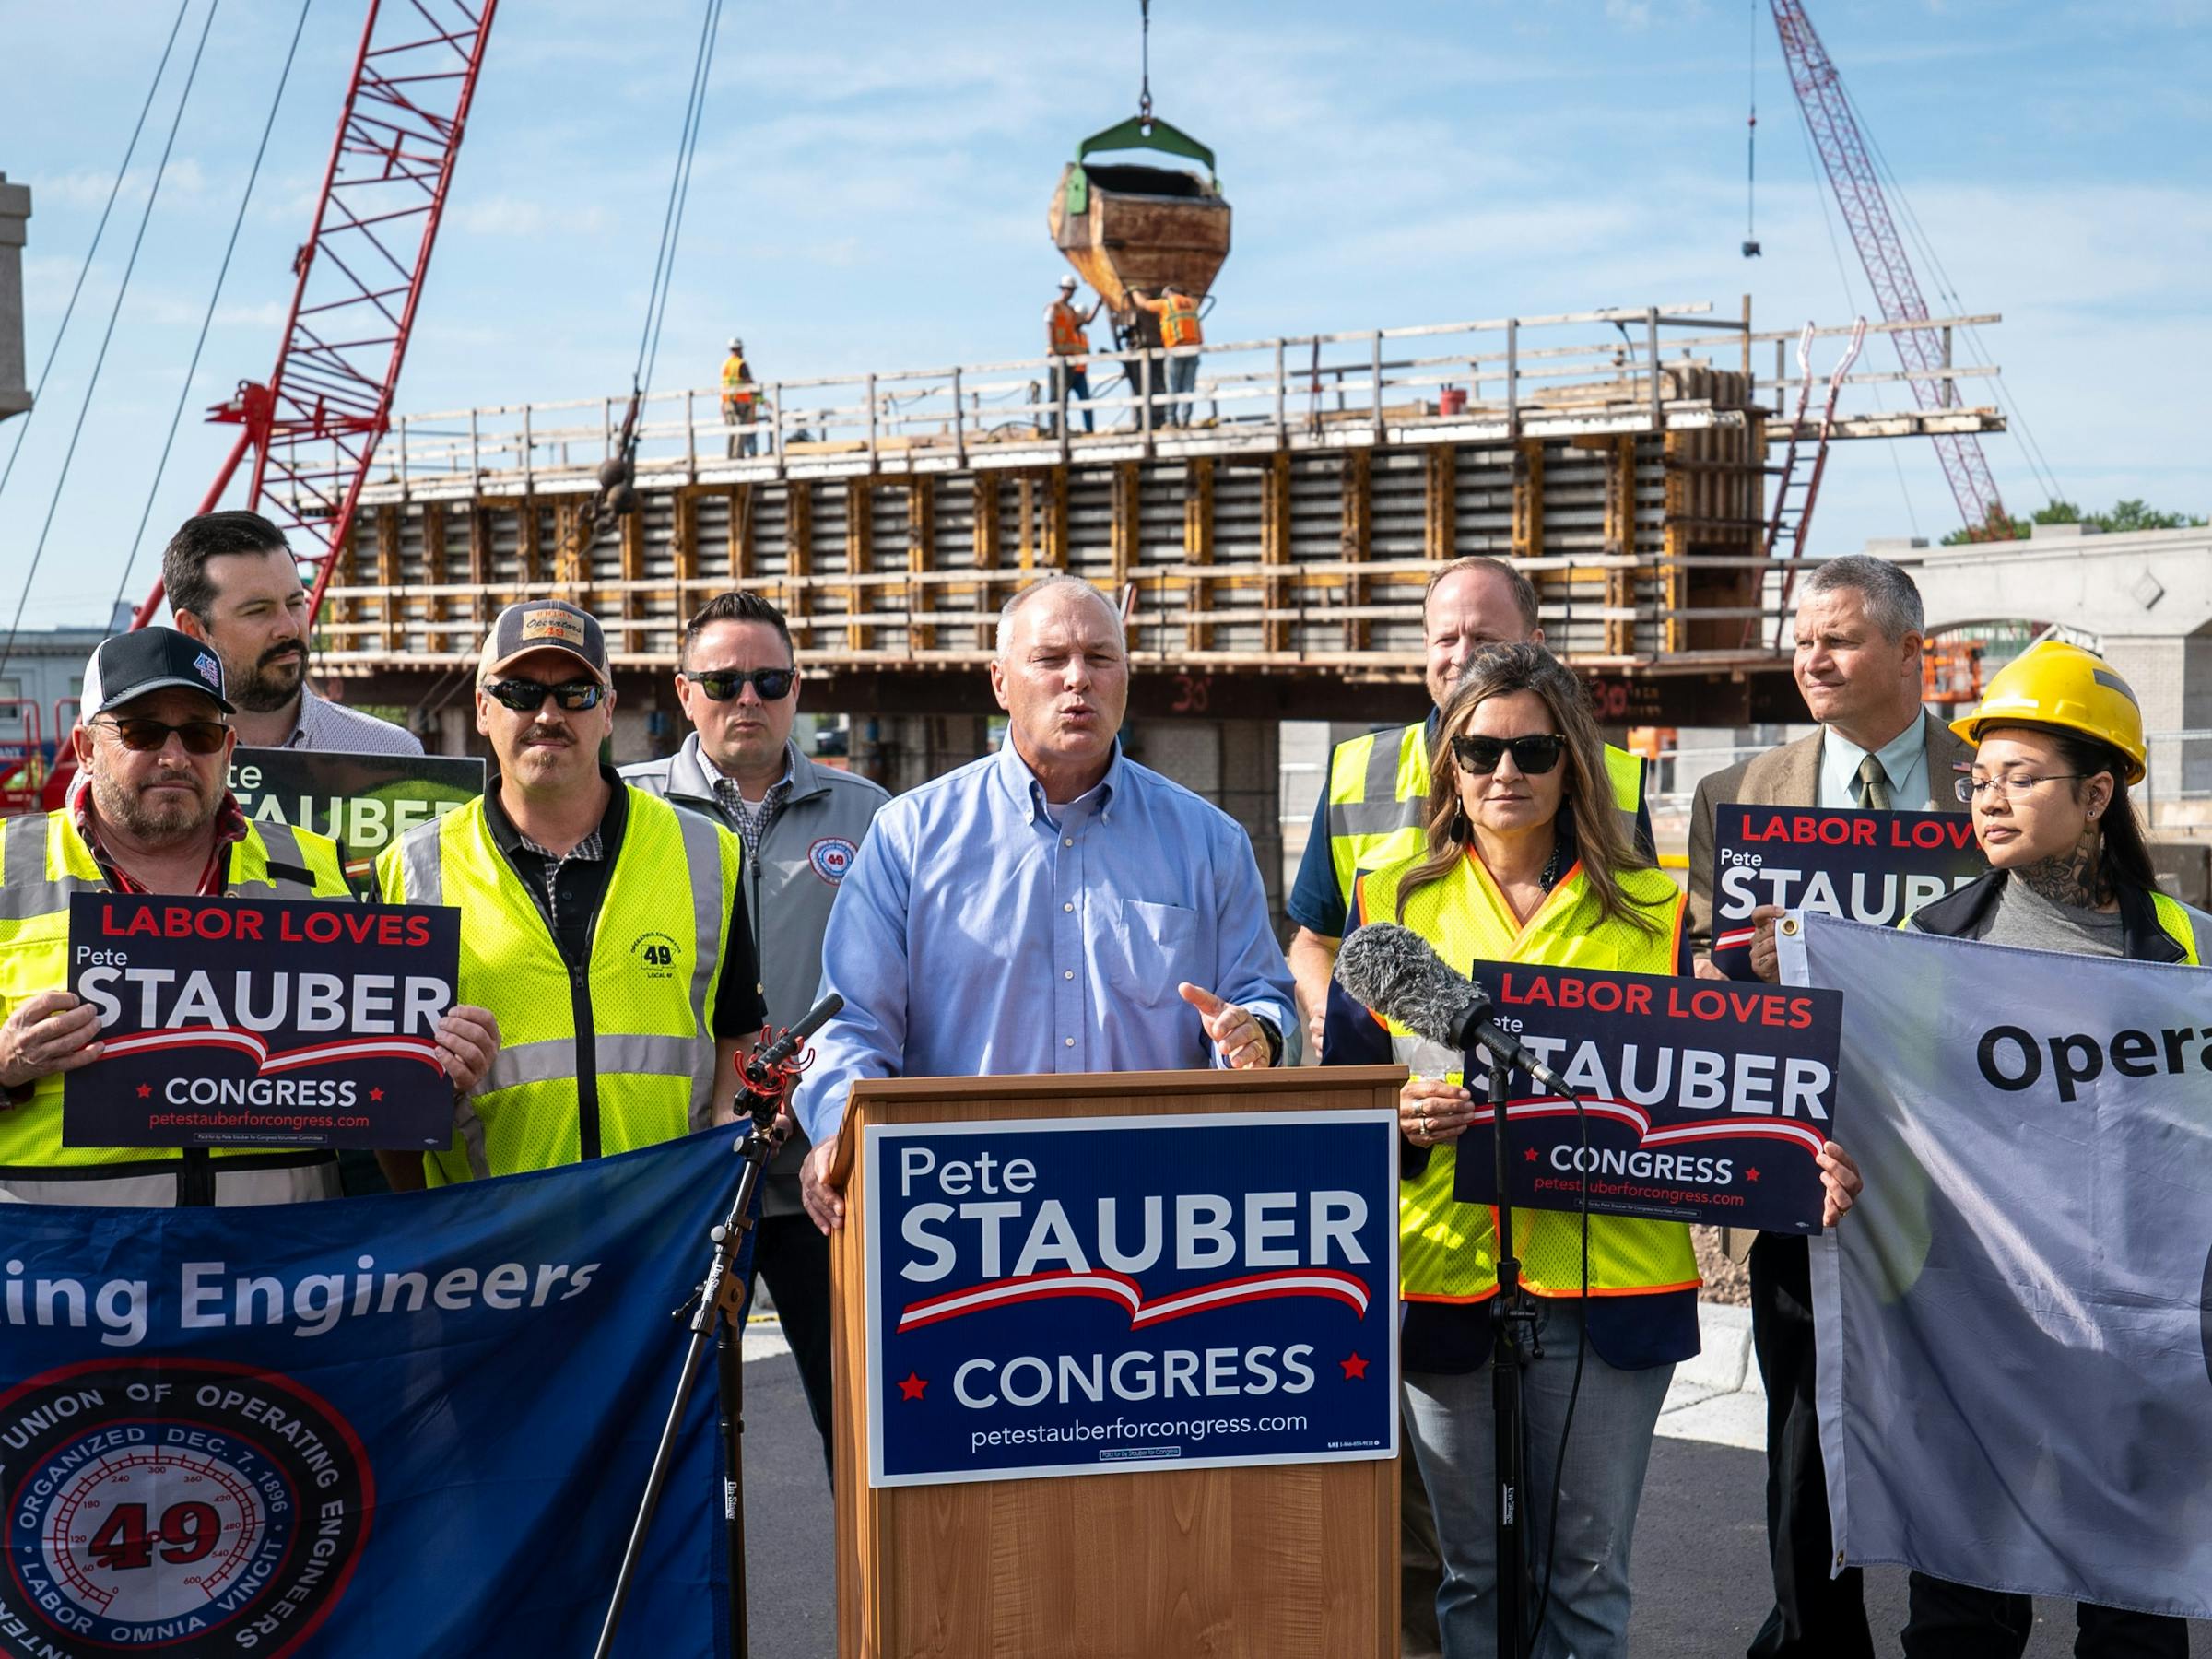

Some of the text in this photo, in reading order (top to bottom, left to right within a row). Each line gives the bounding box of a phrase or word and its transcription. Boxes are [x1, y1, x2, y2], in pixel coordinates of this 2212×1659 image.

[227, 764, 263, 789] te
[231, 793, 466, 848] AUBE
[1742, 814, 1982, 849] LABOR LOV
[1720, 848, 1763, 867] Pete
[1718, 866, 1977, 926] STAUB
[101, 904, 430, 947] LABOR LOVES
[76, 945, 128, 967] Pete
[644, 945, 672, 965] 49
[76, 965, 452, 1035] STAUBER
[1500, 972, 1813, 1030] LABOR LOVES
[1493, 1016, 1524, 1032] te
[165, 1077, 358, 1107] CONGRESS
[148, 1110, 371, 1132] petestauberforcongress.com
[900, 1147, 1037, 1197] Pete
[1549, 1144, 1733, 1185] CONGRESS
[1534, 1176, 1745, 1206] petestuberforcongress.com
[899, 1189, 1371, 1283] STAUBER
[4, 1254, 602, 1347] ing Engineers
[952, 1343, 1316, 1410] CONGRESS
[971, 1411, 1308, 1453] petestauberforcongress.com
[18, 1427, 146, 1530] ORGANIZED
[166, 1427, 229, 1458] DEC.
[258, 1470, 288, 1512] 1896
[111, 1475, 130, 1483] 240
[147, 1465, 167, 1475] 300
[183, 1475, 203, 1483] 360
[1, 1382, 345, 1650] UNION OF OPERATING ENGINEERS
[213, 1494, 232, 1503] 420
[69, 1535, 88, 1544] 120
[88, 1500, 222, 1572] 49
[21, 1542, 284, 1643] LABOR OMNIA VINCIT
[183, 1575, 202, 1585] 600
